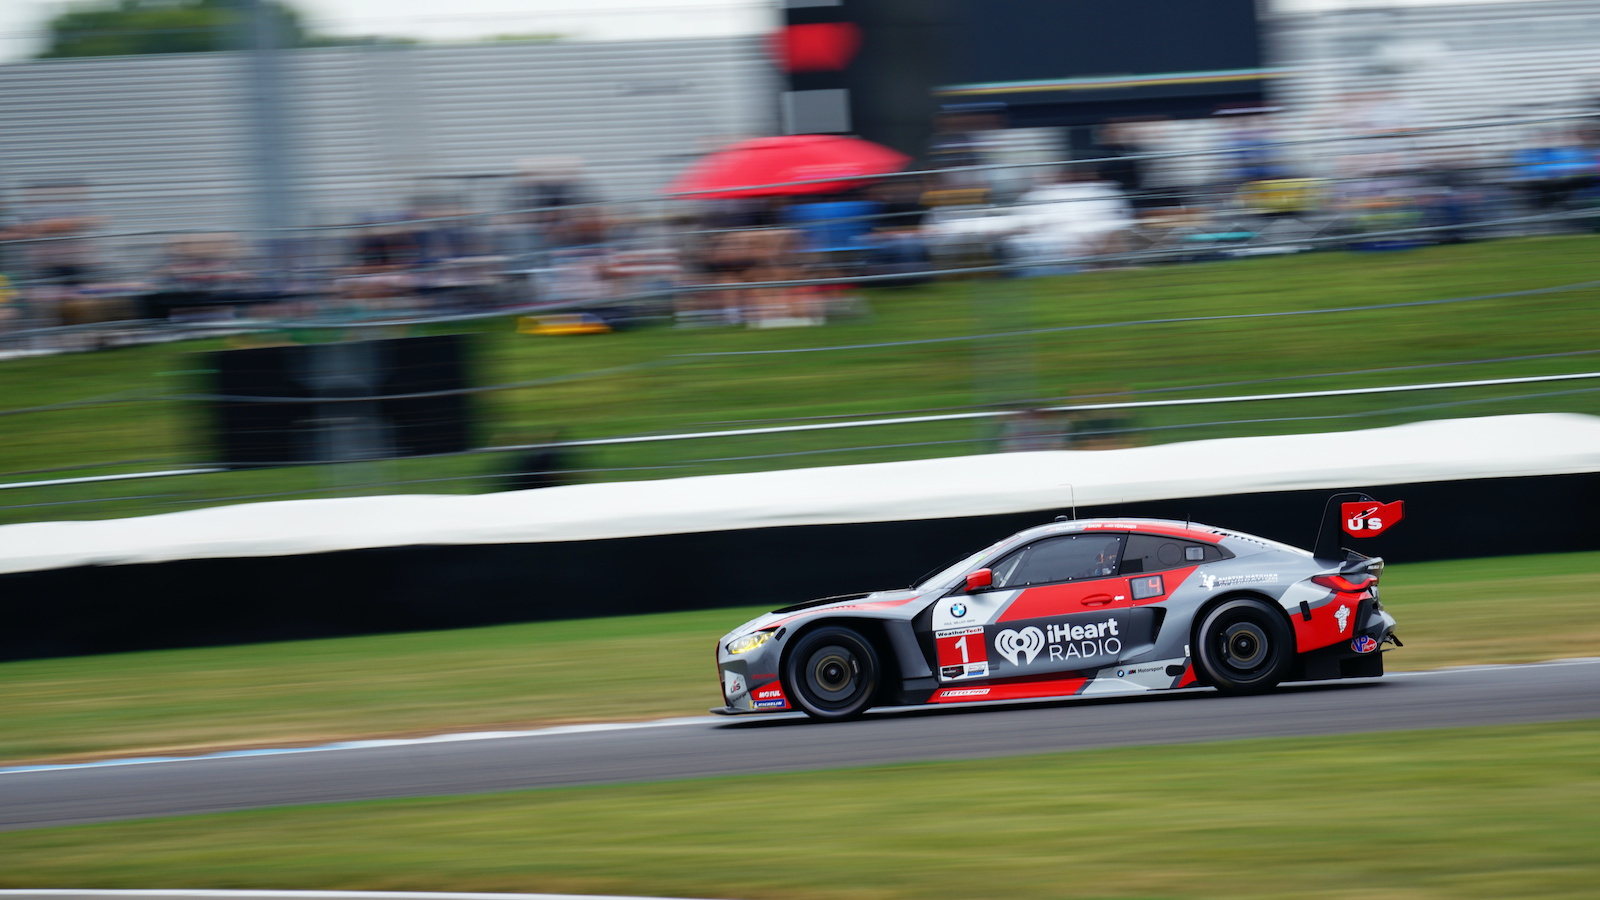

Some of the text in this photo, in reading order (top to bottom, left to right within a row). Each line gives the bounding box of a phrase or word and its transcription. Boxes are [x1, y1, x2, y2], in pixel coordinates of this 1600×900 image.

[1149, 577, 1160, 593] 4
[938, 628, 982, 637] WeatherTech
[1047, 618, 1119, 643] iHeart
[955, 636, 969, 663] 1
[1049, 637, 1122, 662] RADIO
[1352, 635, 1368, 652] VP
[758, 690, 780, 698] MOTUL
